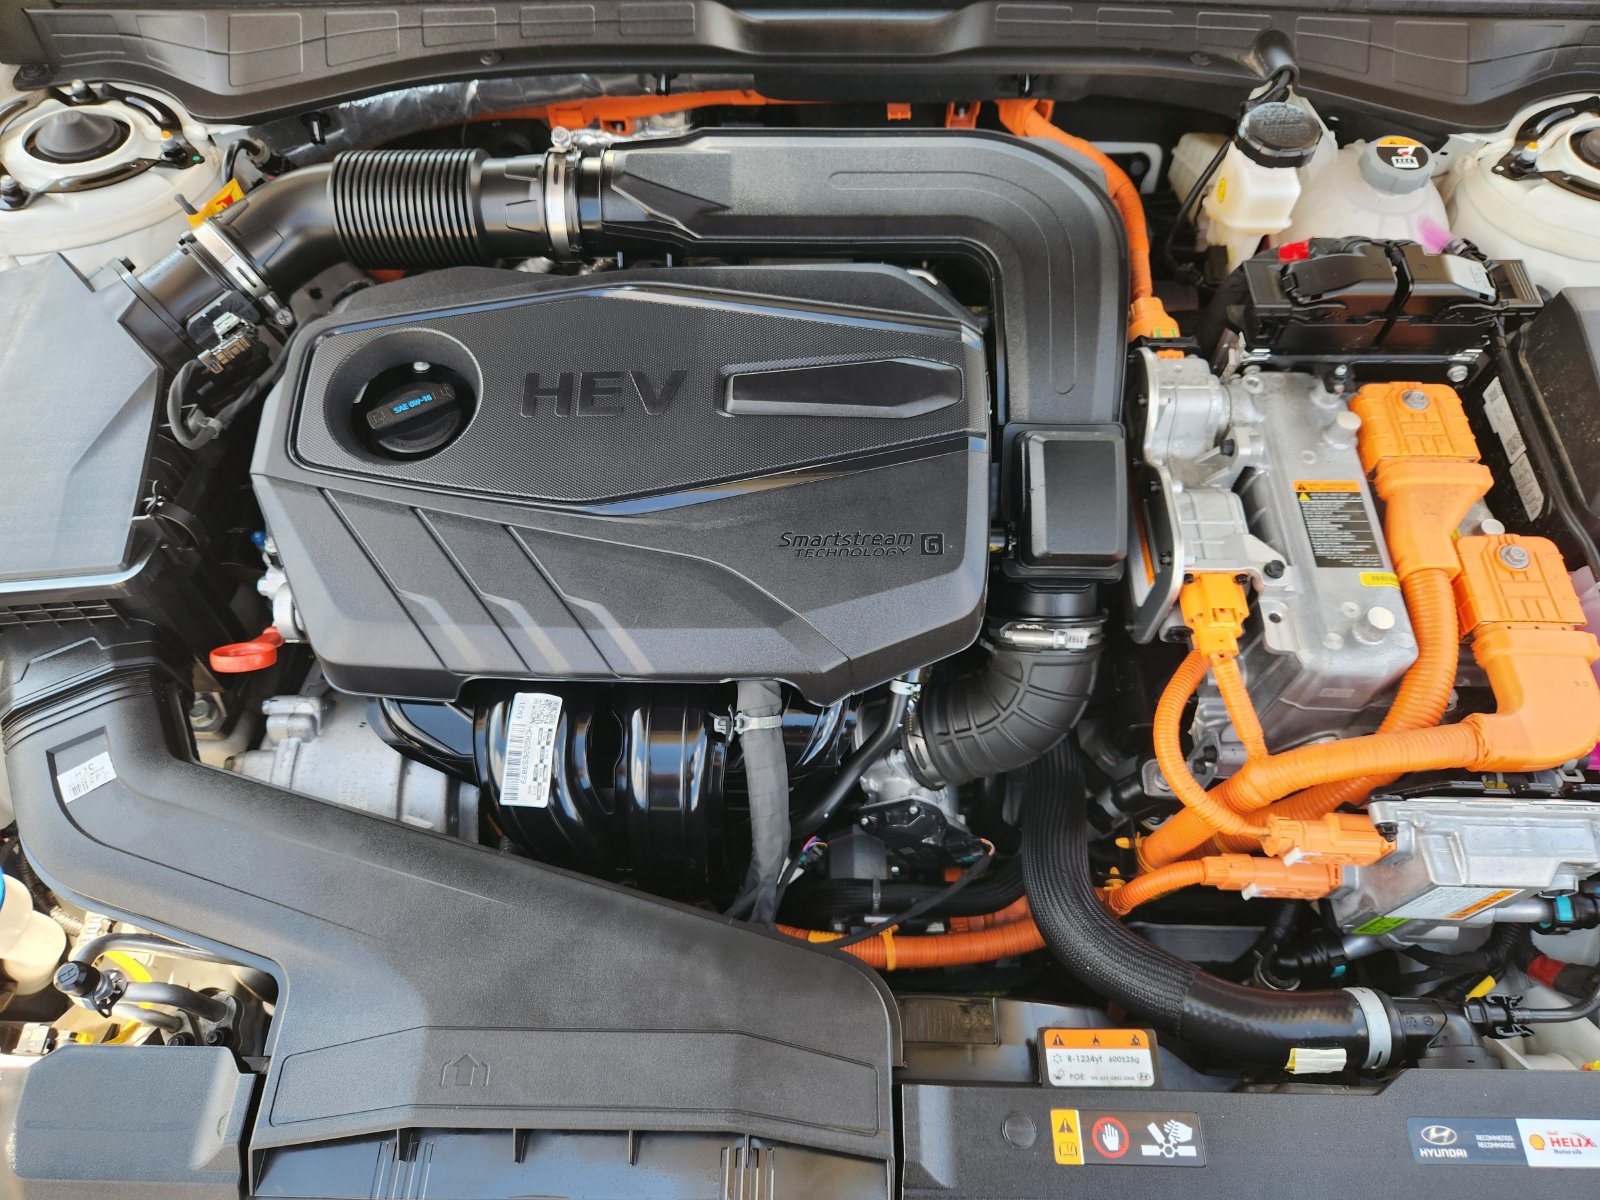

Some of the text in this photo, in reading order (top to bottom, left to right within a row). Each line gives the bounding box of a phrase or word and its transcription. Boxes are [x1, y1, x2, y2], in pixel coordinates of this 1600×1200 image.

[521, 369, 688, 417] HEV
[392, 402, 409, 414] SAE
[778, 530, 915, 548] Smartstream
[1067, 1055, 1103, 1064] R-1234yf
[1549, 1136, 1595, 1148] HELIX
[1420, 1147, 1468, 1158] HYUNDAI
